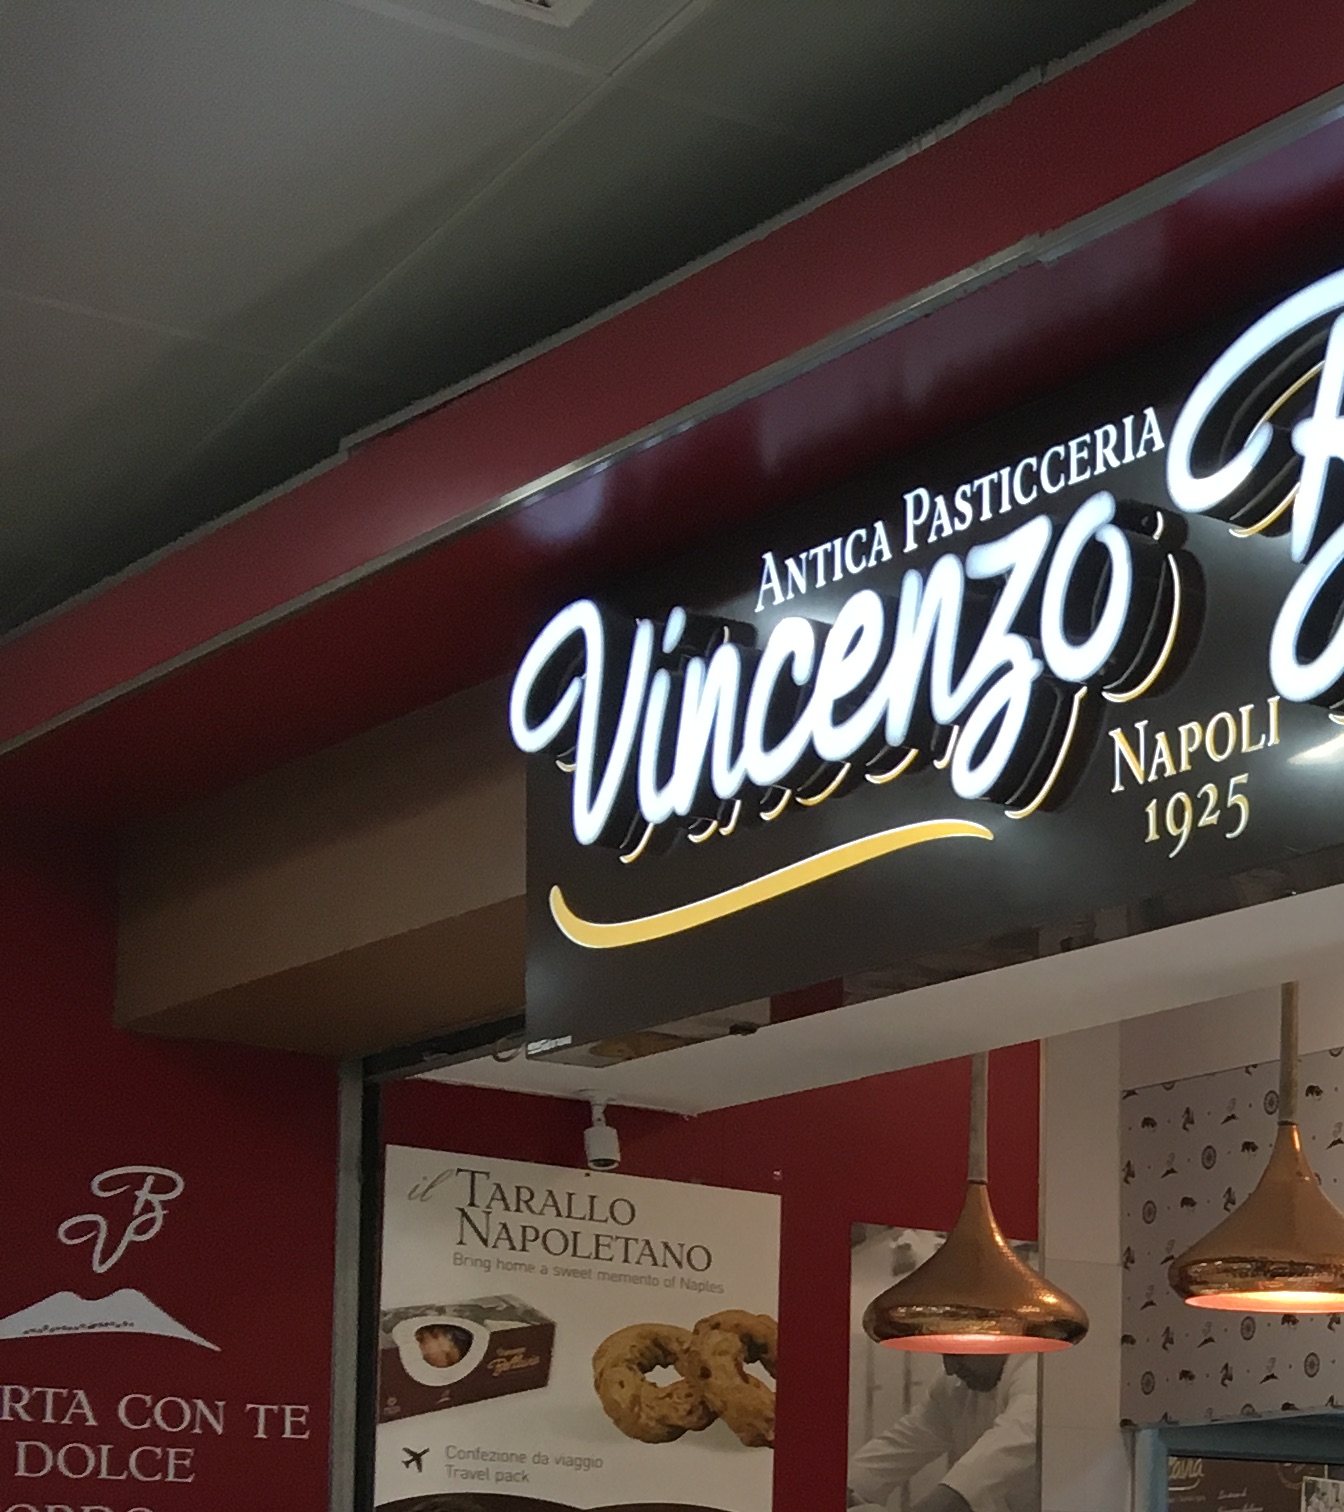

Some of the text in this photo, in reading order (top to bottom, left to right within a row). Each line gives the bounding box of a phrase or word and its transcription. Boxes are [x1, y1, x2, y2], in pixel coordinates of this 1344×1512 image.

[755, 407, 1166, 613] ANTICA PASTICCERIA
[509, 492, 1134, 847] Vincenzo
[1109, 696, 1281, 792] NAPOLI
[1145, 774, 1251, 858] 1925
[456, 1168, 636, 1226] TARALLO
[455, 1207, 713, 1272] NAPOLETANO
[452, 1252, 725, 1294] Bring home a sweet memento of Naples
[117, 1393, 226, 1435] CON
[246, 1403, 310, 1440] TE
[14, 1441, 195, 1483] DOLCE
[445, 1445, 603, 1471] Confezione da viaggio
[445, 1464, 530, 1485] Travel pack
